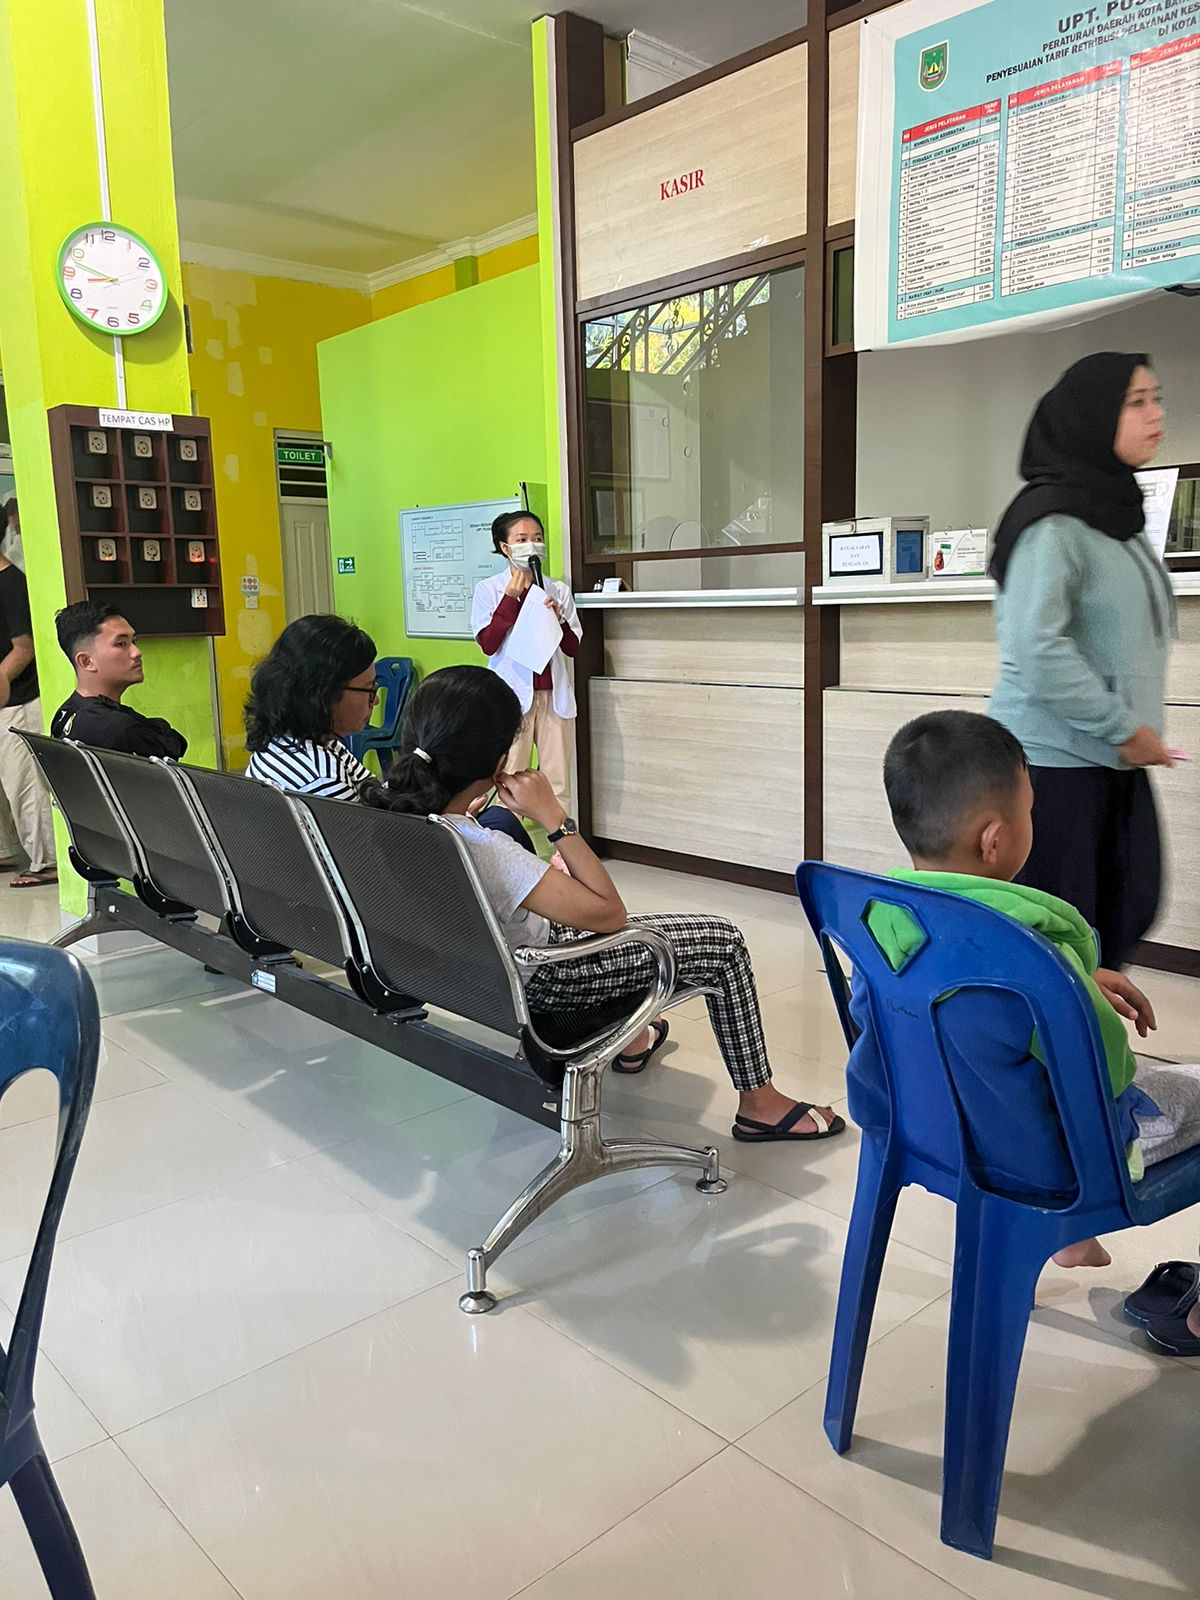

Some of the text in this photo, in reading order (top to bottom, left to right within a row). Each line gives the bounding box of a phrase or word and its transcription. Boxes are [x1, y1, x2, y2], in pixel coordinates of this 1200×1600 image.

[1058, 6, 1100, 33] UPT.
[1042, 26, 1095, 52] PERATURAN
[1097, 12, 1135, 33] DAERAH
[1138, 3, 1162, 19] KOTA
[1158, 16, 1196, 36] DI KOTA
[986, 57, 1043, 83] PENYESUAIAN
[1046, 47, 1070, 63] TARIF
[660, 169, 705, 200] KASIR
[85, 233, 94, 244] 11
[101, 230, 116, 242] 12
[138, 258, 150, 269] 2
[63, 266, 75, 278] 9
[145, 279, 158, 290] 3
[70, 288, 82, 299] 8
[141, 300, 153, 311] 4
[86, 307, 99, 319] 7
[128, 313, 140, 324] 5
[107, 316, 119, 327] 6
[102, 414, 170, 426] TEMPAT CAS HP
[284, 451, 316, 460] TOILET
